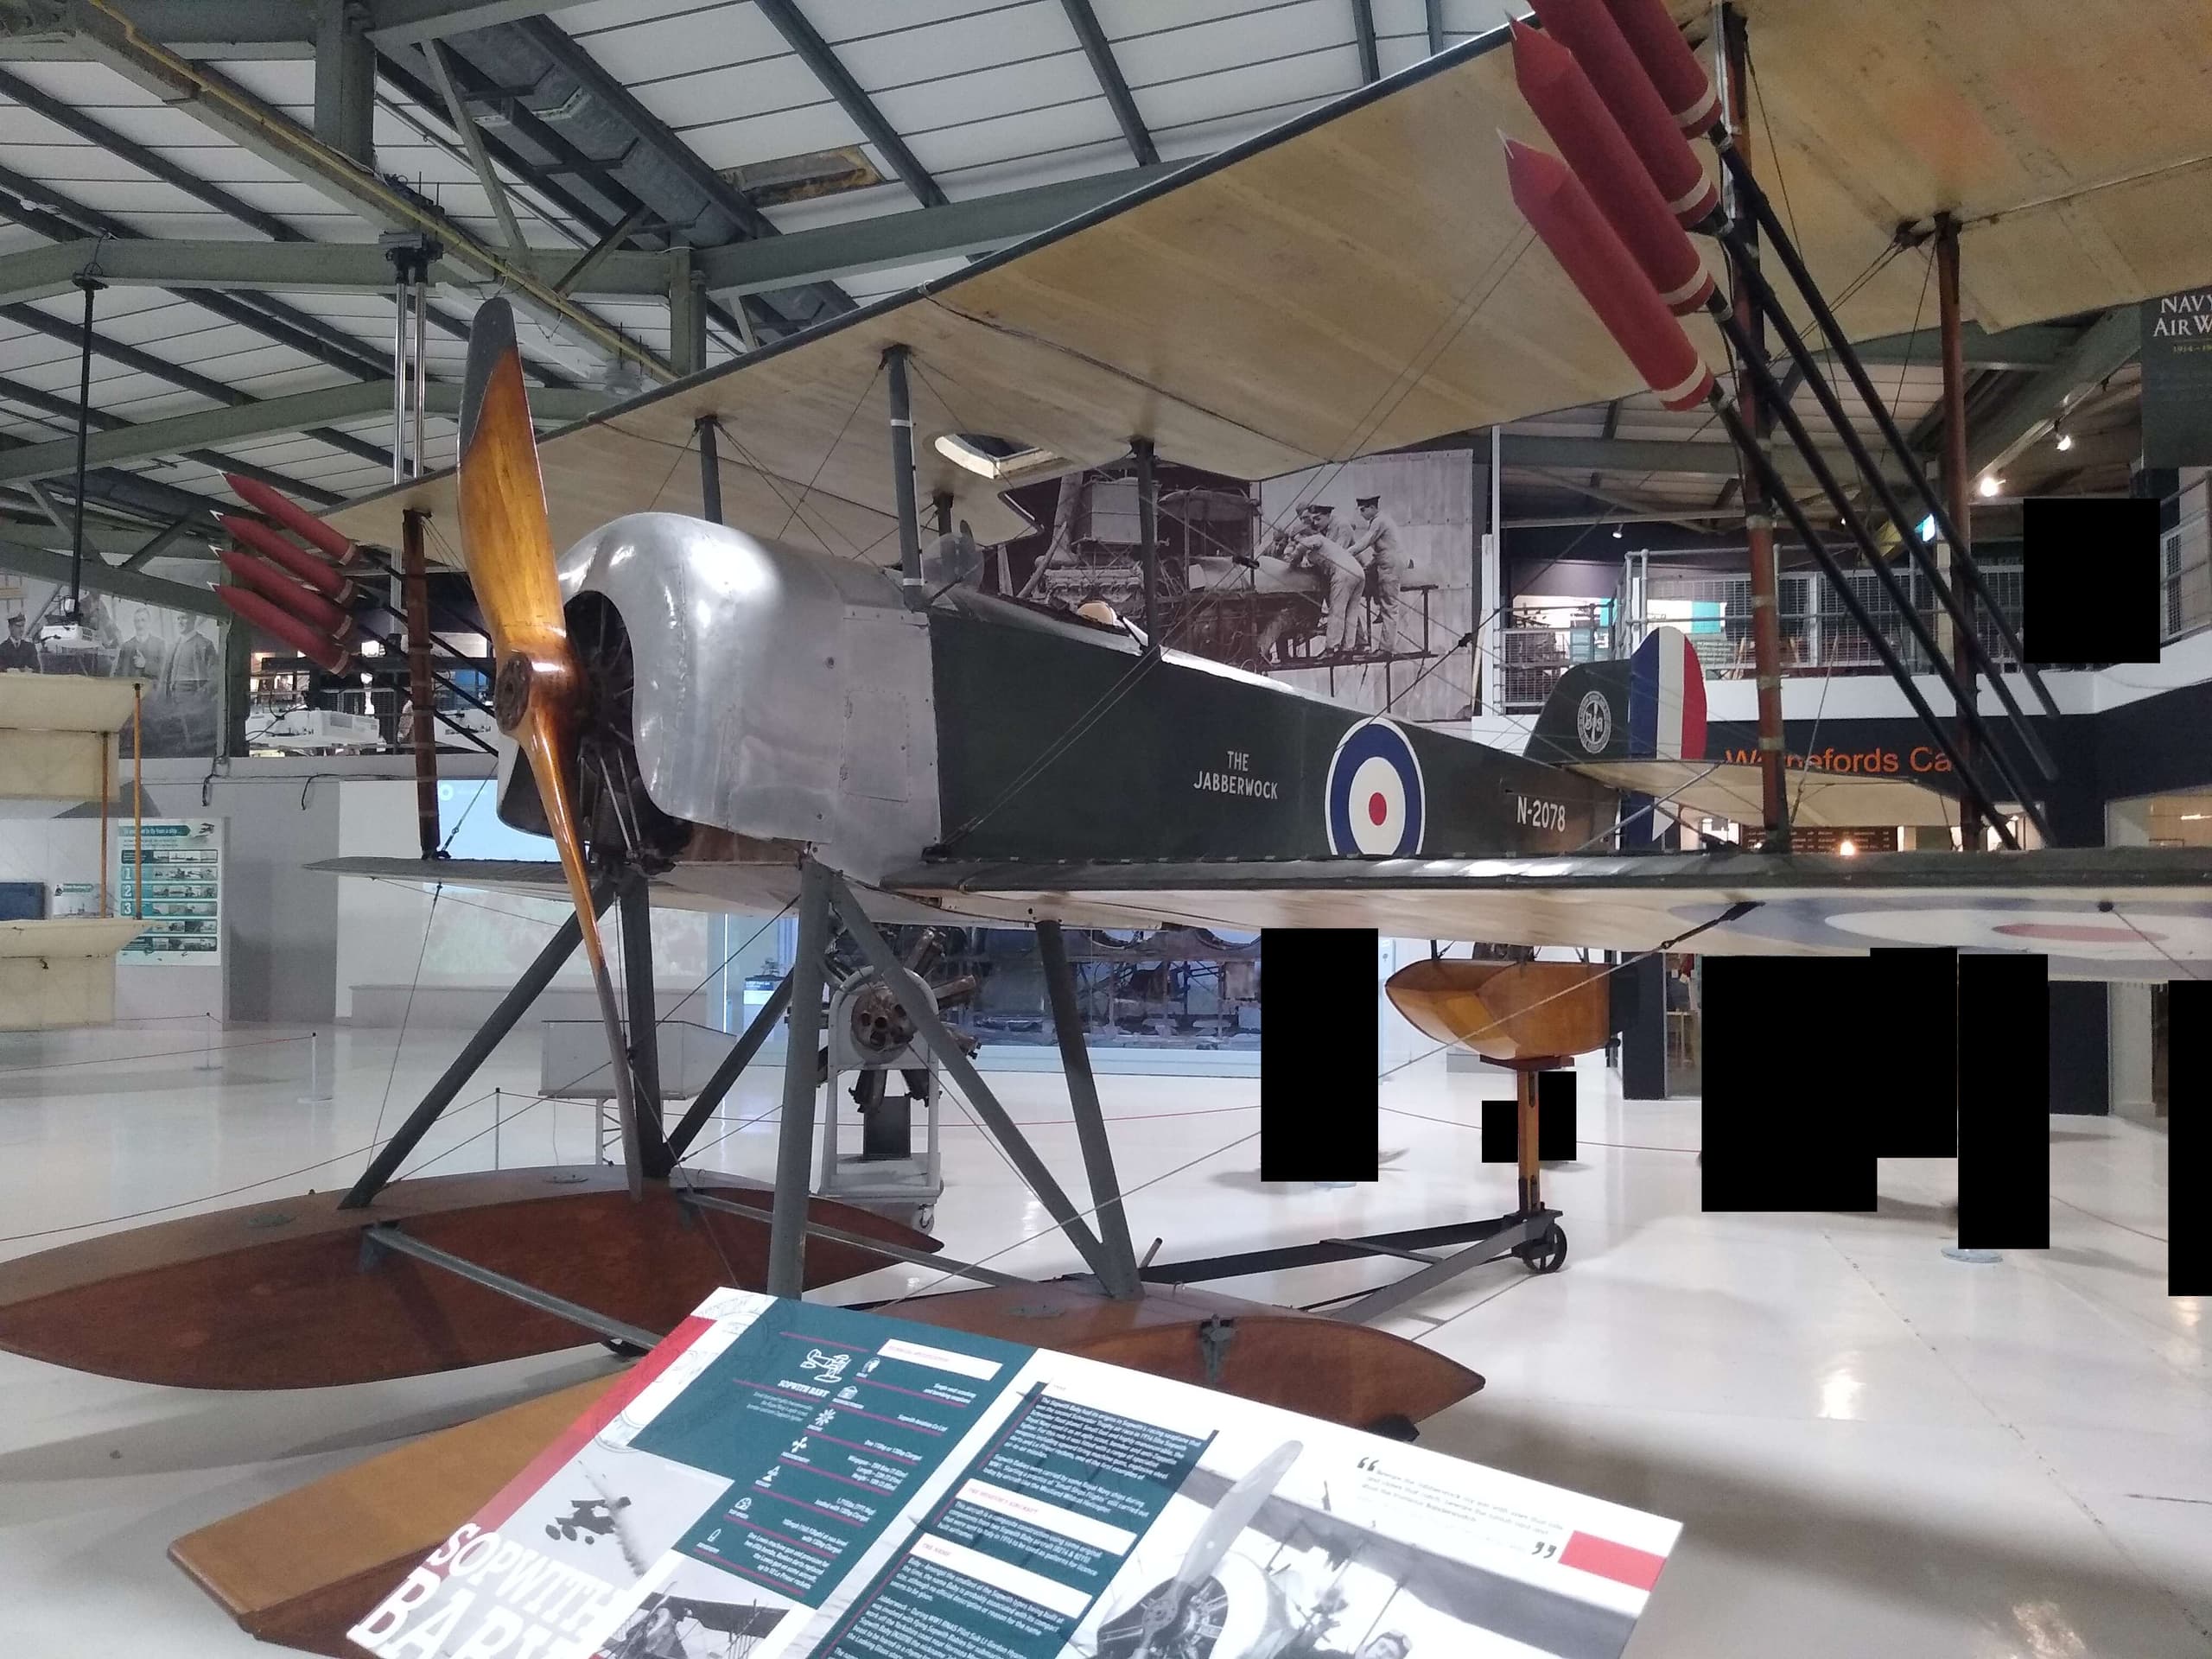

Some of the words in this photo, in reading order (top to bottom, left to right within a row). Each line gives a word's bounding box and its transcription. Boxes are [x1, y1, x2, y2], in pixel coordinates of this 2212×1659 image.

[1227, 751, 1249, 772] THE
[1193, 771, 1278, 799] JABBERWOCK
[1516, 795, 1566, 832] N-2078
[125, 868, 131, 880] 1
[124, 885, 132, 898] 2
[124, 903, 131, 915] 3
[427, 1523, 629, 1640] SOPWITH
